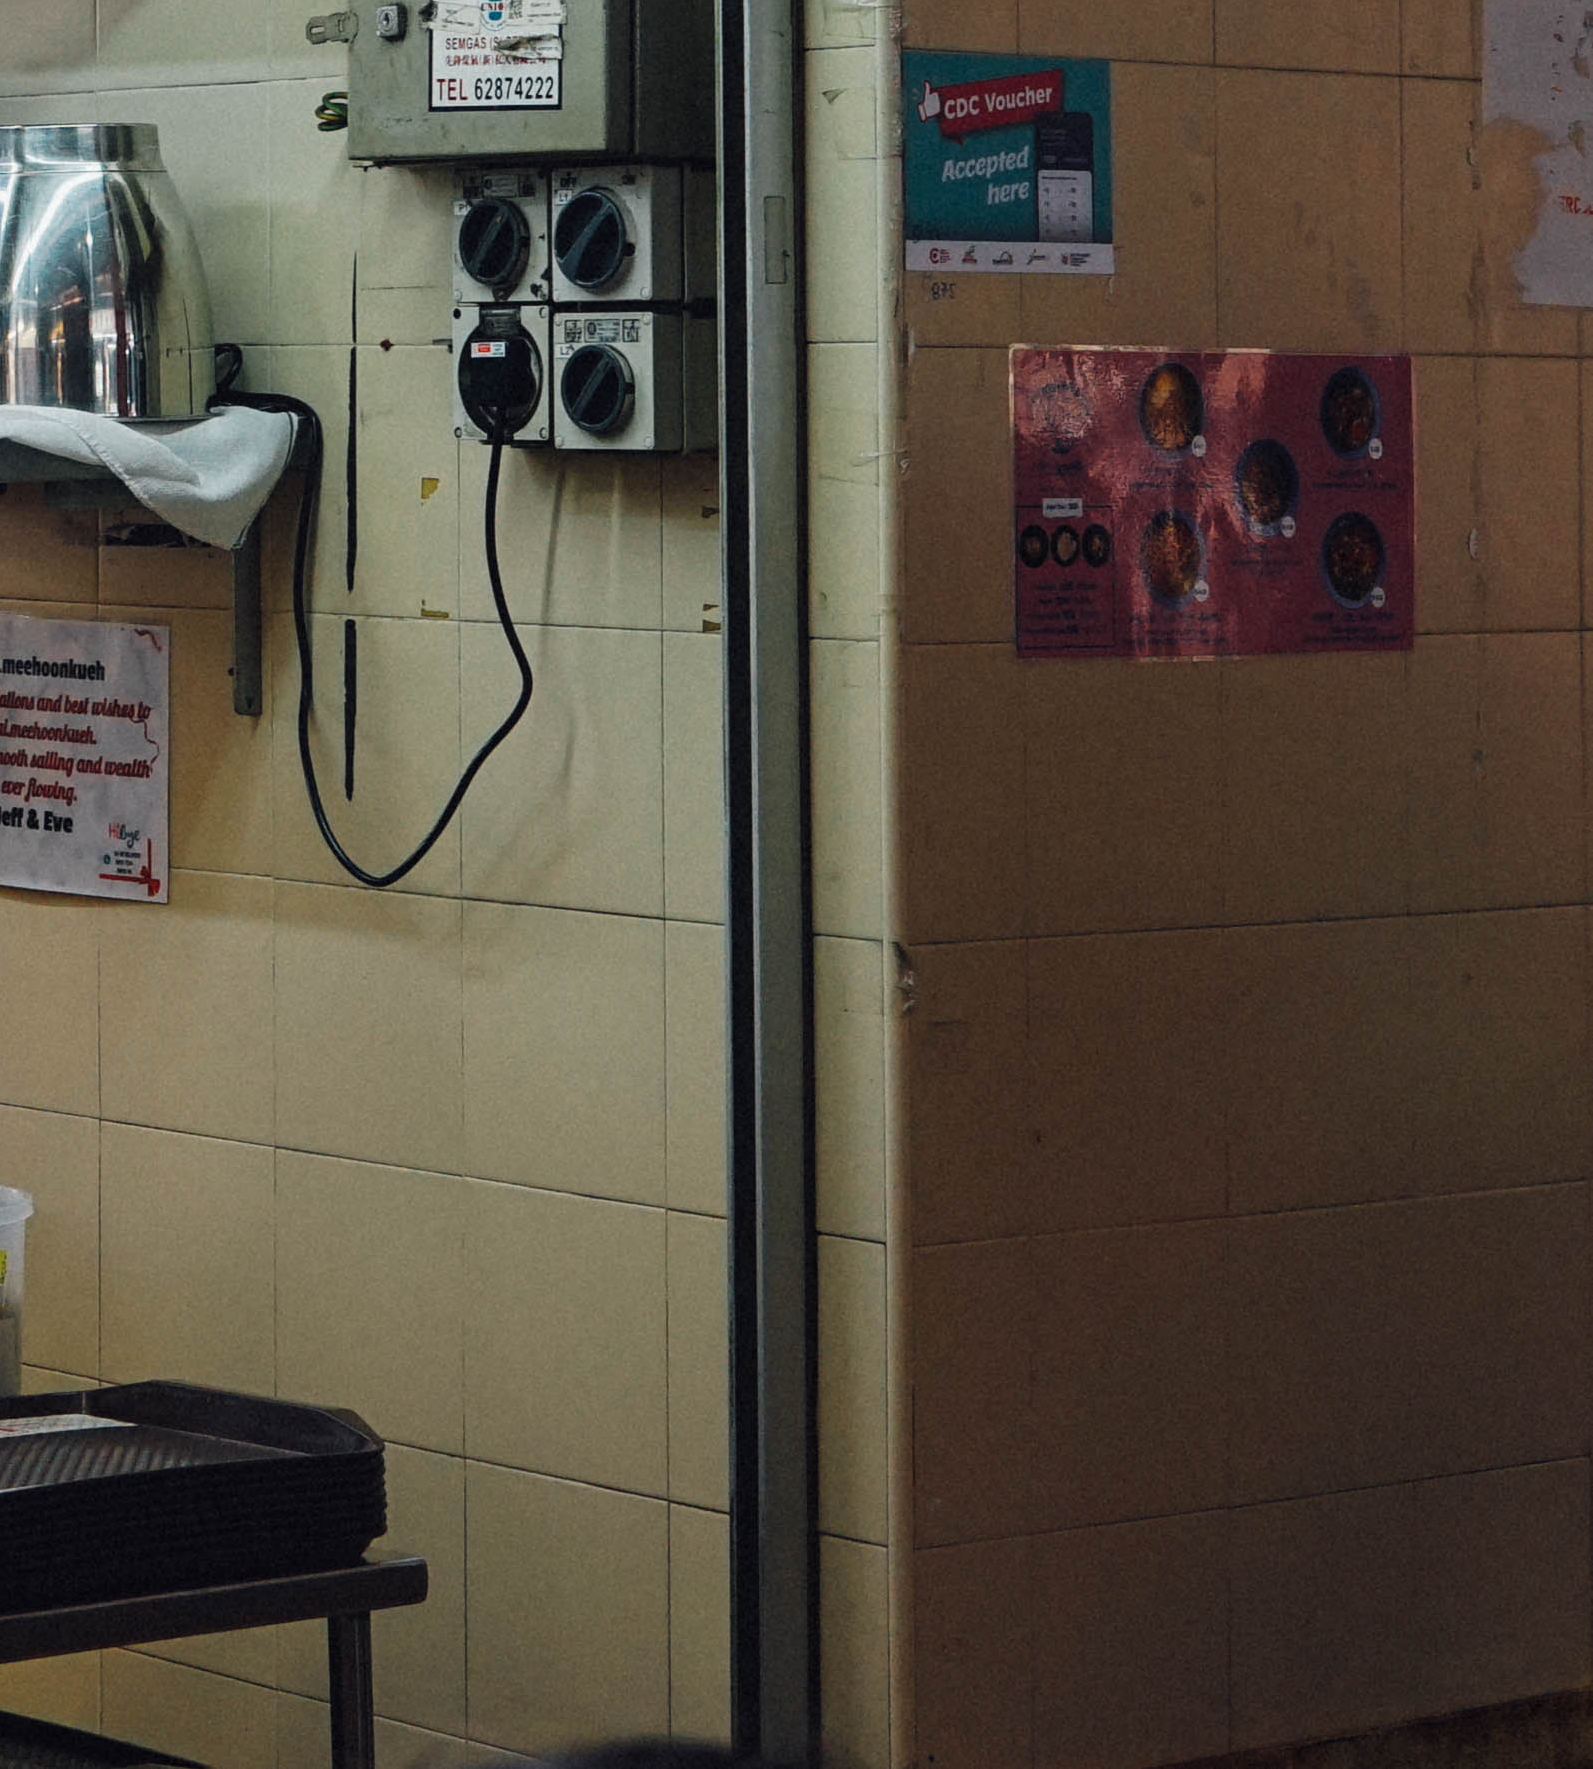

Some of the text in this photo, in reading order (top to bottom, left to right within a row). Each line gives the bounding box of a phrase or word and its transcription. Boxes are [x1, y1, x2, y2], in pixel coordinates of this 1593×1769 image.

[445, 37, 487, 51] SEMGAS
[437, 76, 555, 101] TEL 62874222
[943, 86, 1053, 120] CDC Voucher
[941, 145, 1030, 182] Accepted
[986, 181, 1030, 205] here
[37, 695, 62, 712] and
[64, 697, 89, 714] best
[91, 699, 135, 718] wishes
[136, 702, 151, 720] to
[30, 751, 74, 777] sailing
[76, 756, 103, 774] and
[104, 759, 151, 779] wealth
[1, 777, 78, 806] ever flowing.
[43, 811, 74, 833] Eve
